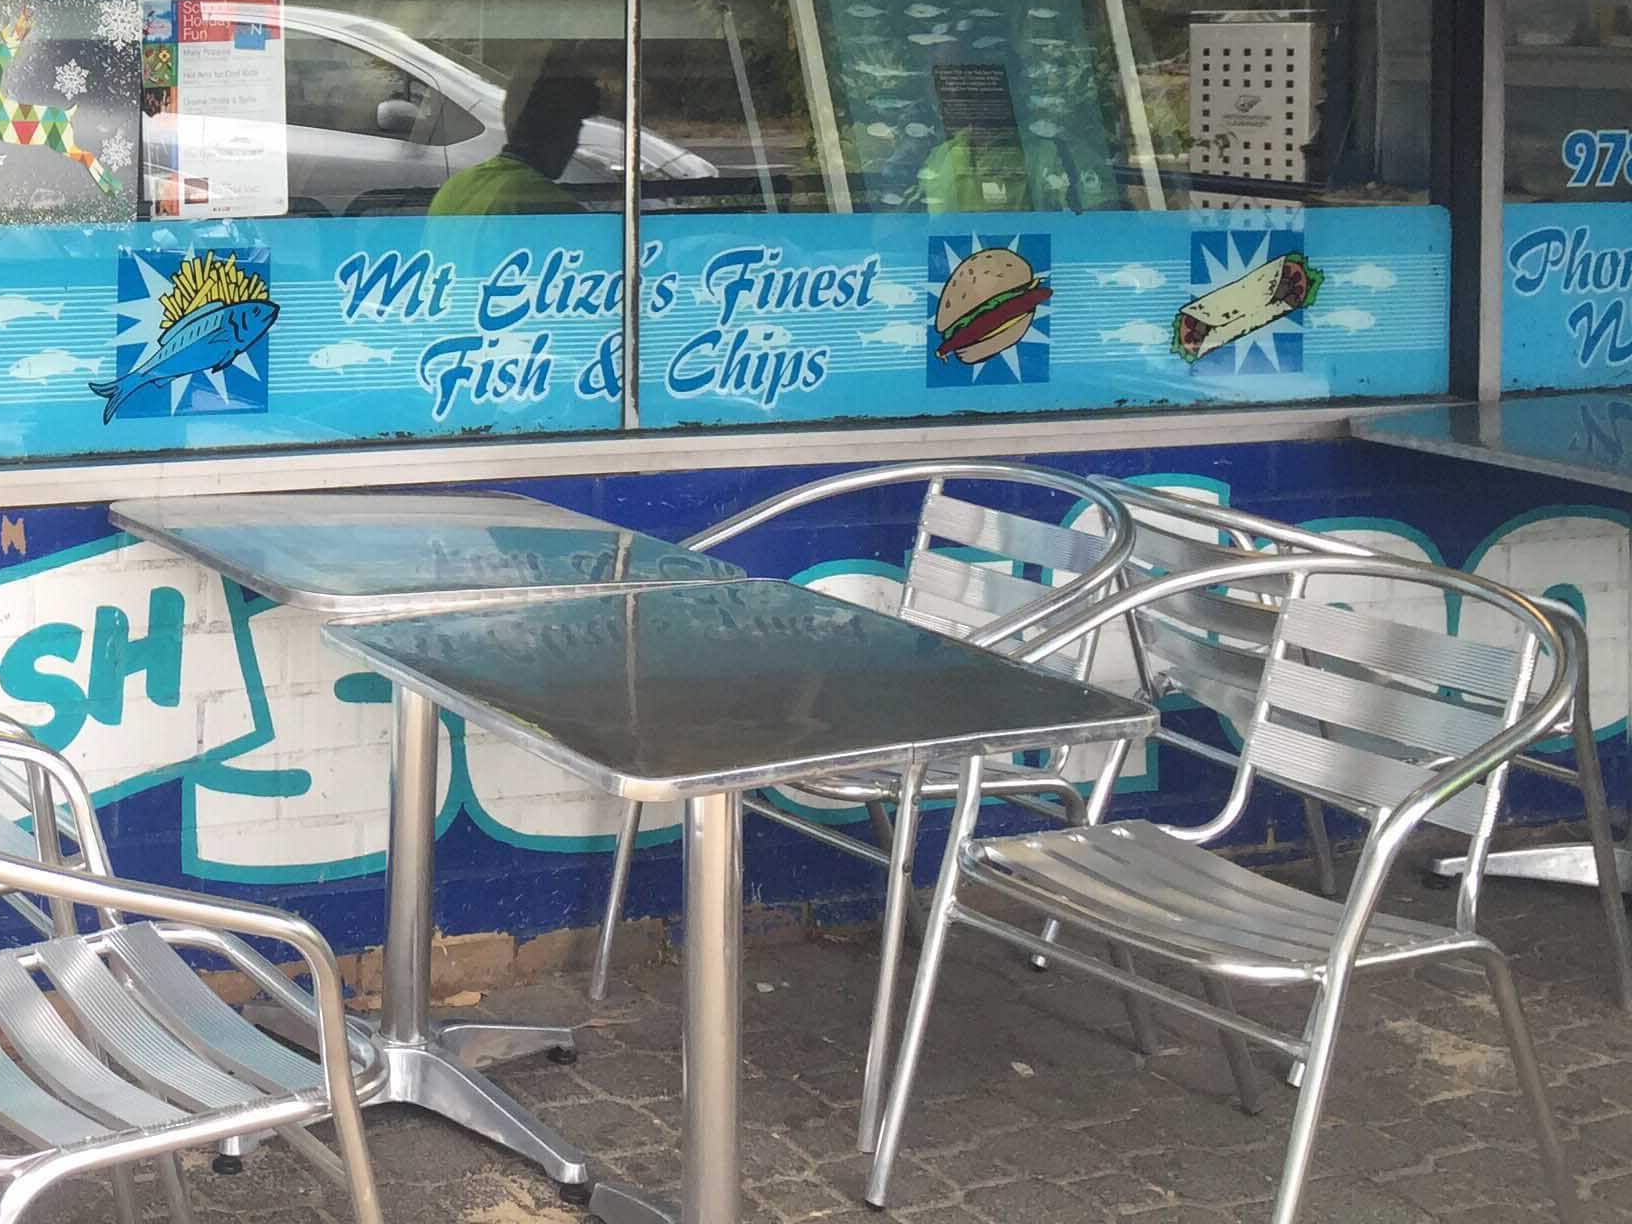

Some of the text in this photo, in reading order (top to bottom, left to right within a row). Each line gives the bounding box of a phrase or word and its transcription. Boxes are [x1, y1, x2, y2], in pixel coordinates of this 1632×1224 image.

[183, 28, 208, 40] Fun
[1563, 129, 1632, 187] 97
[336, 250, 455, 323] Mt
[704, 244, 880, 327] Finest
[418, 326, 830, 423] Fish & Chips
